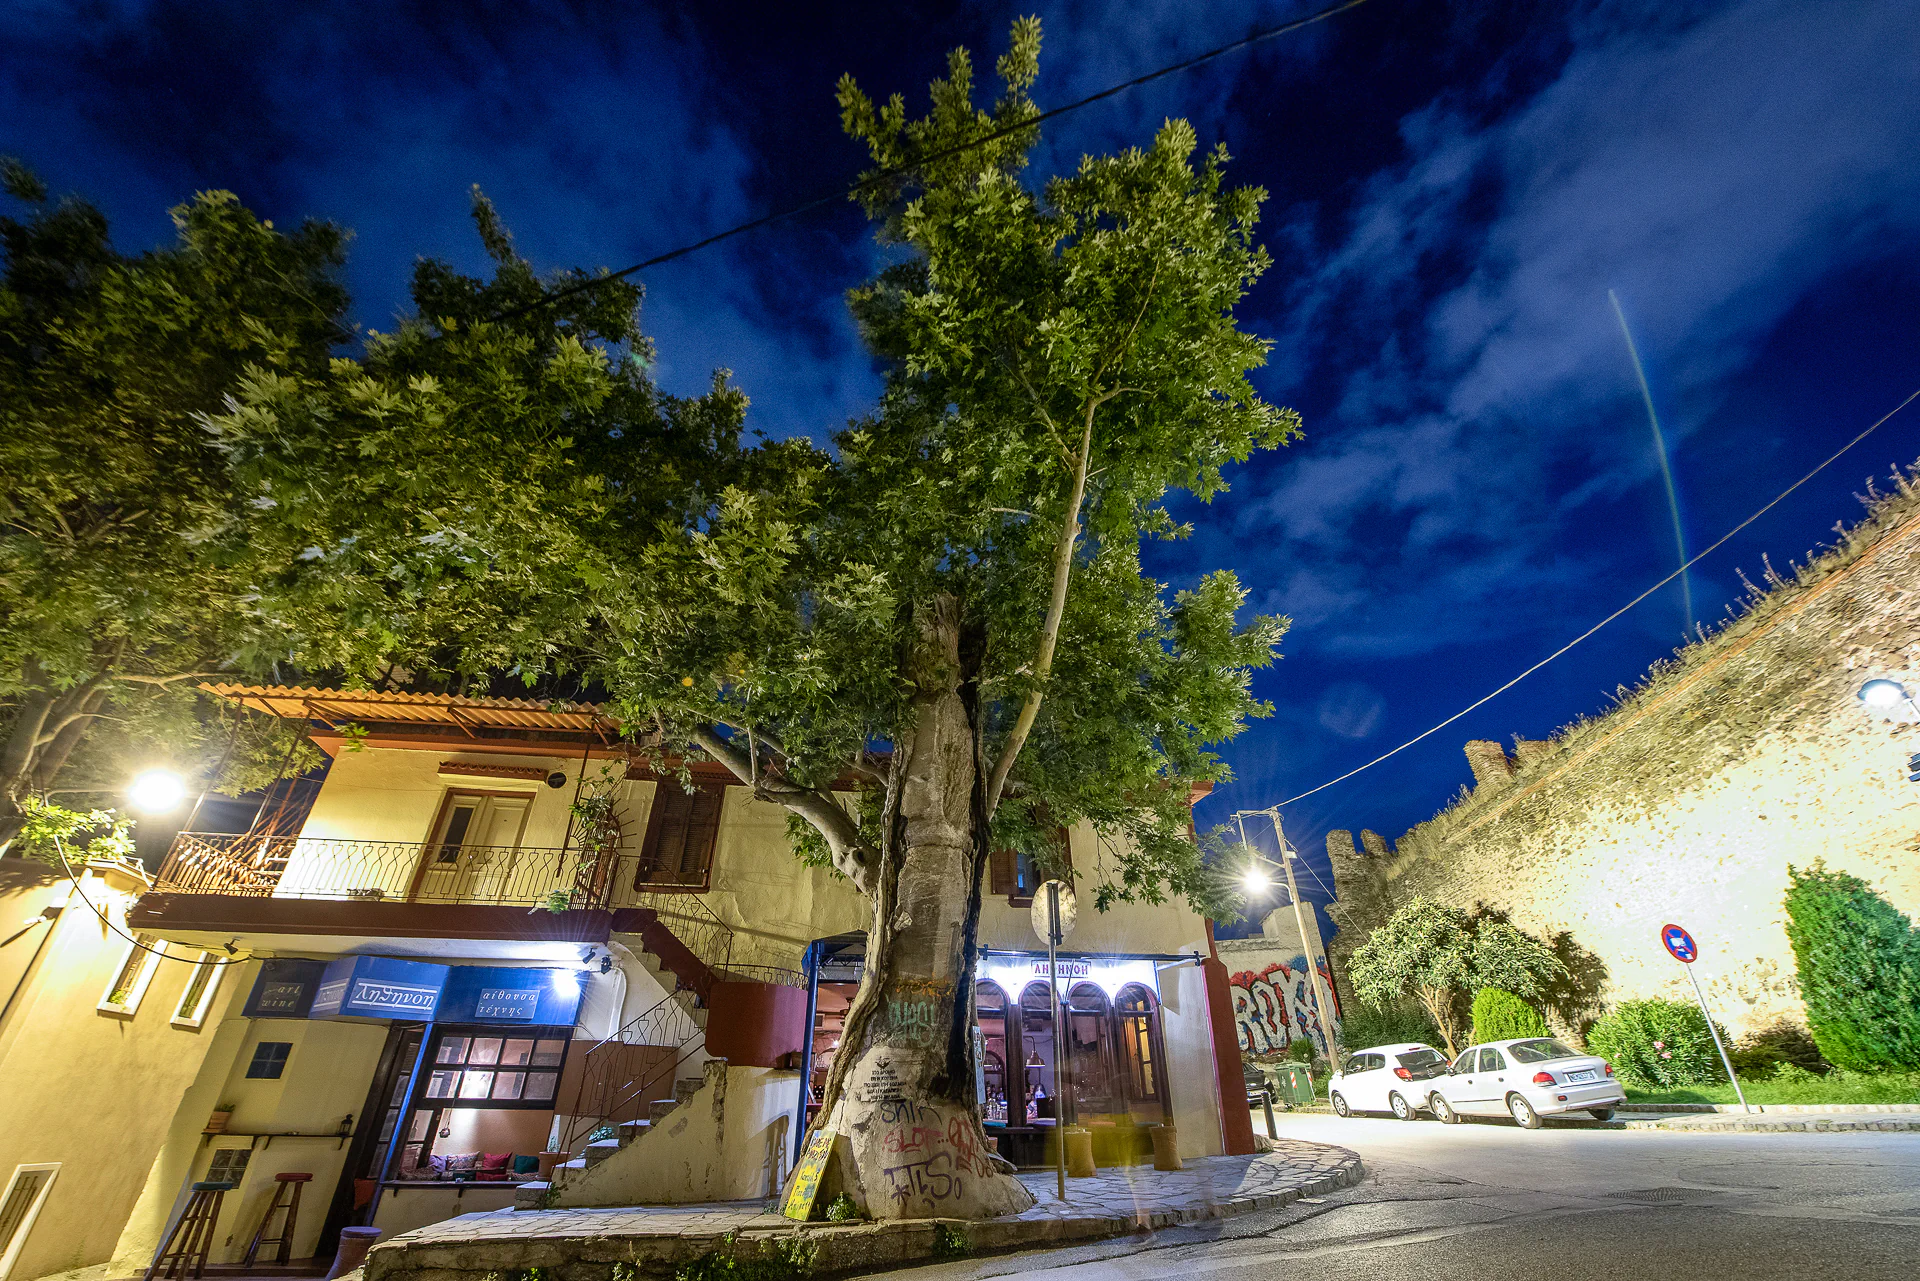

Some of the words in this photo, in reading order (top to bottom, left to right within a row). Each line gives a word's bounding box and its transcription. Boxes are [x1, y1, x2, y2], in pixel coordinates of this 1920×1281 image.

[1034, 963, 1088, 975] ΛΗΗΝΟΗ
[482, 990, 536, 1001] αίθουσα
[261, 997, 295, 1008] wine
[479, 1003, 523, 1017] τέχνης
